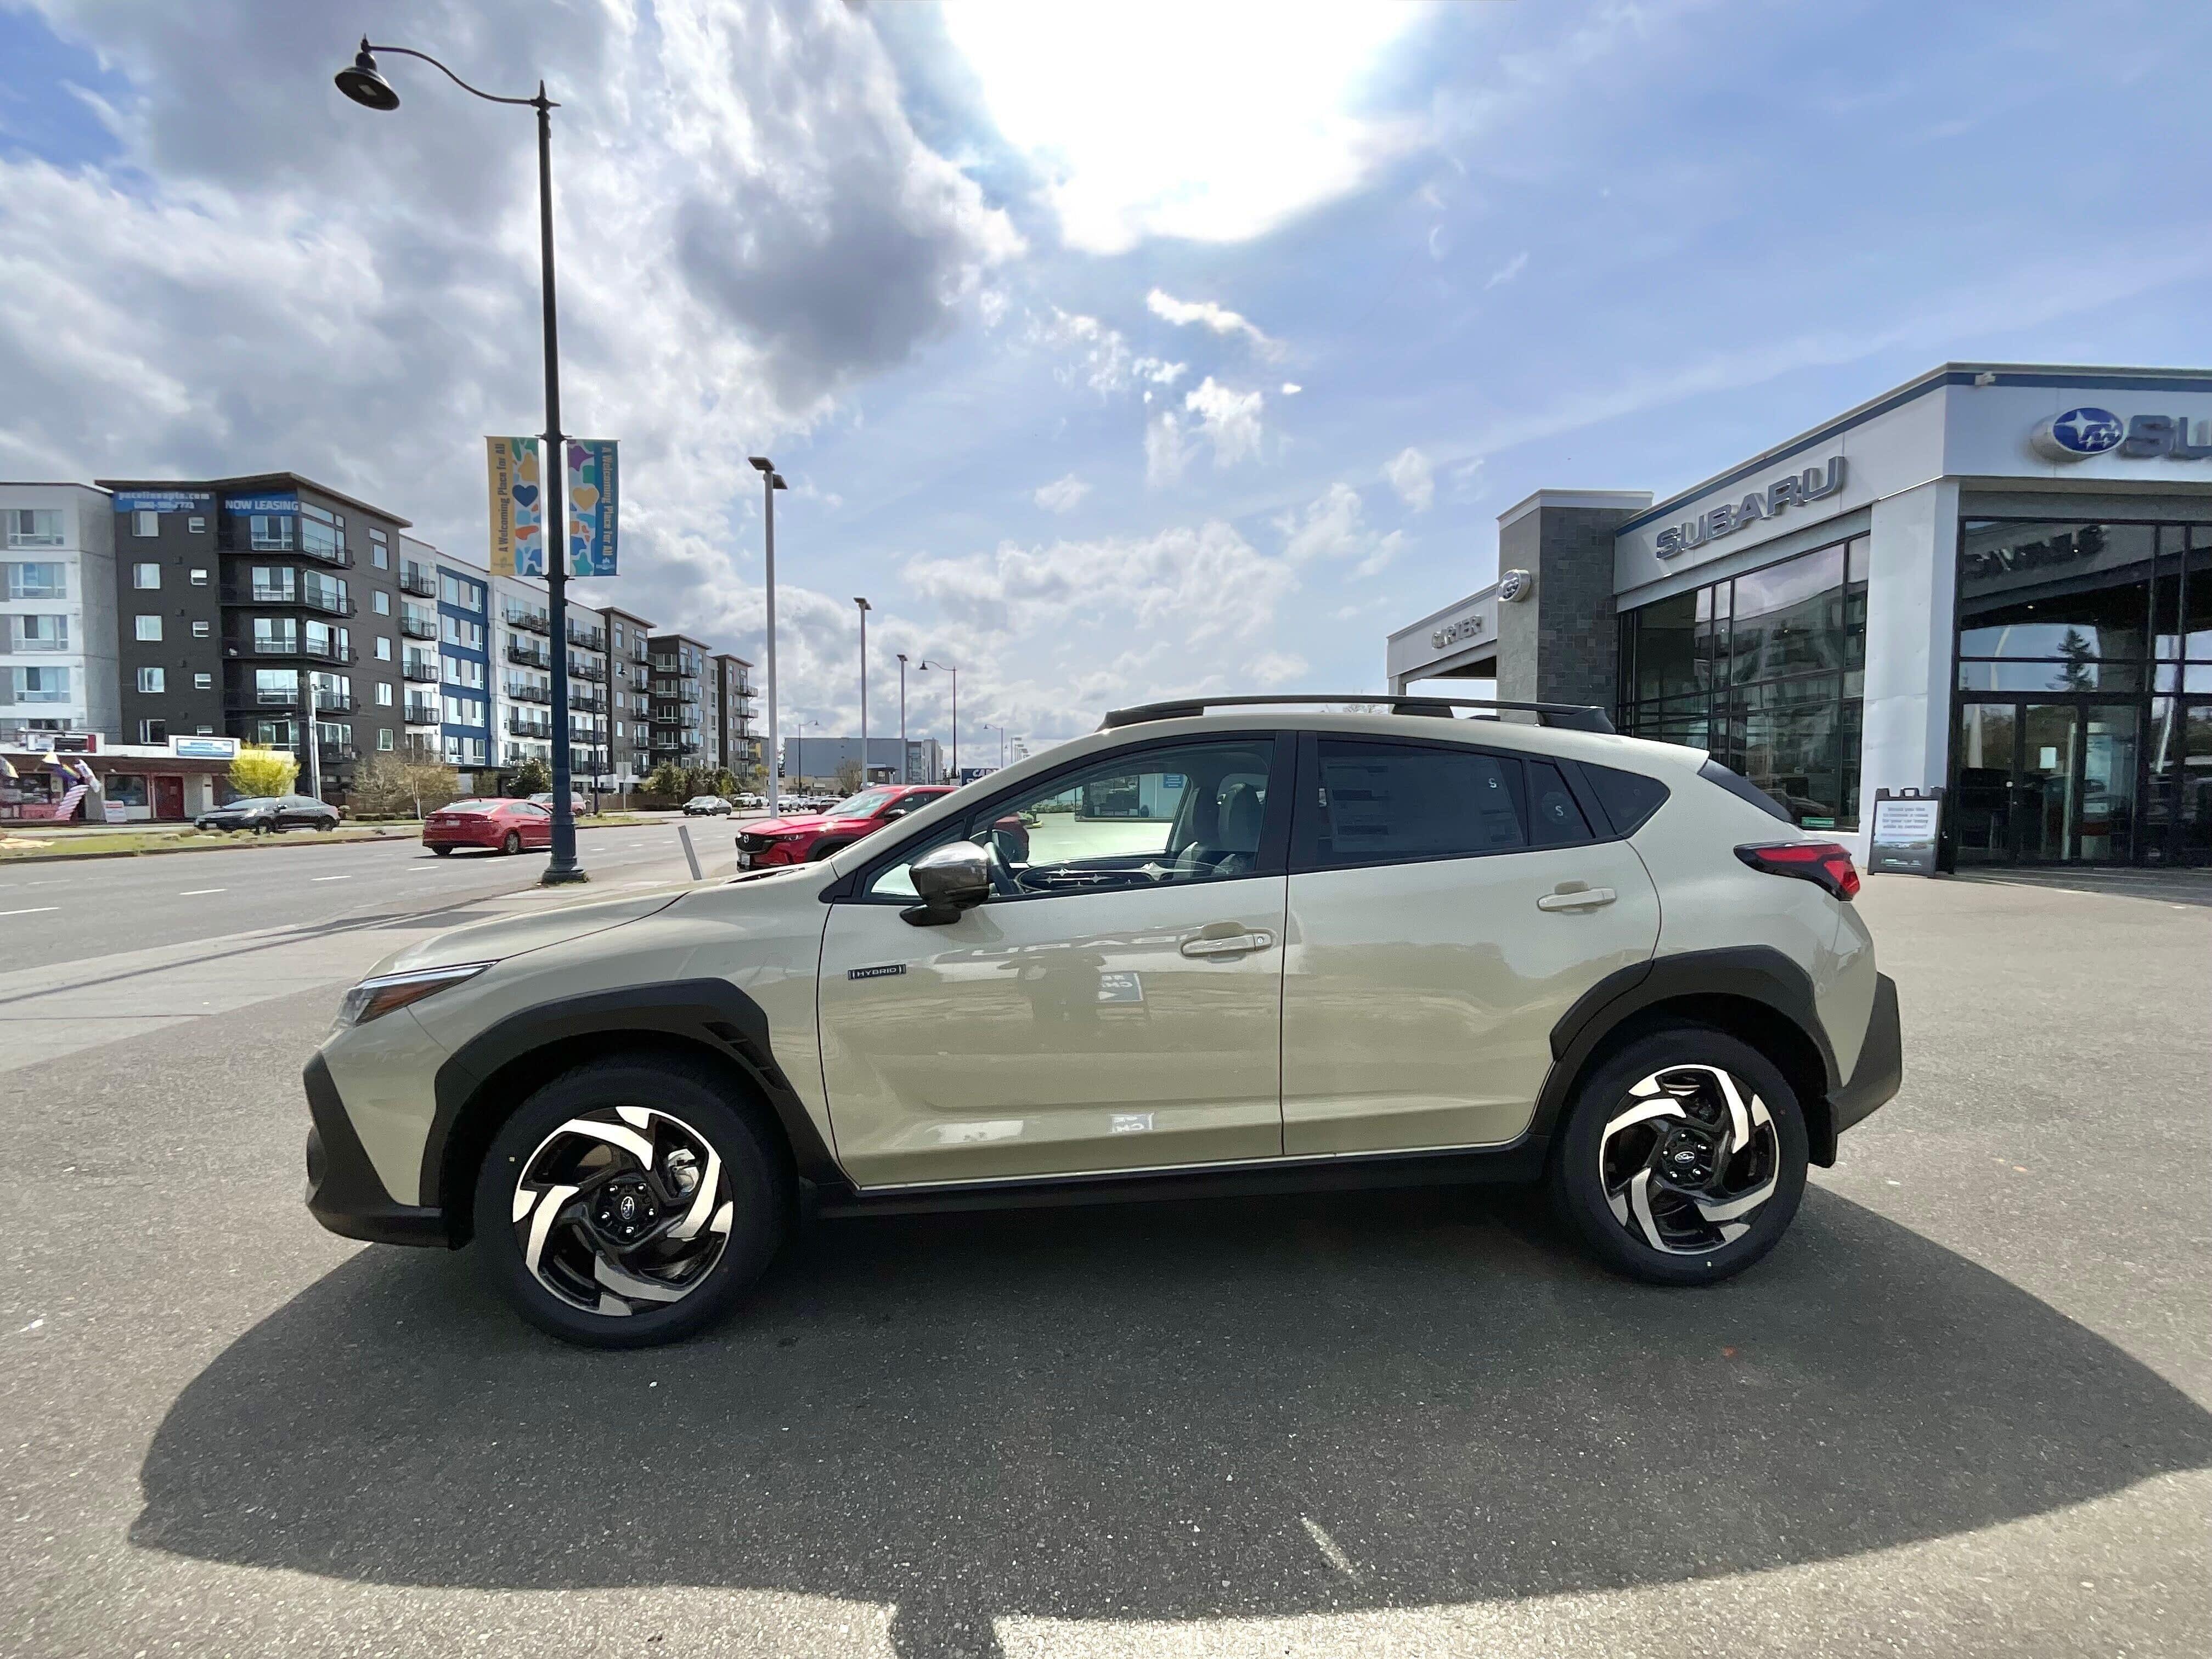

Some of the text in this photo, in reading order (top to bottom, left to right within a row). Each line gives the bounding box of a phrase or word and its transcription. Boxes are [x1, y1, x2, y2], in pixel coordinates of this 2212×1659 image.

[495, 443, 505, 455] All
[496, 458, 506, 469] for
[498, 472, 508, 496] Place
[601, 455, 613, 504] Welcoming
[225, 500, 299, 511] NOW LEASING
[1656, 456, 1845, 560] SUBARU
[498, 498, 510, 545] Welcoming
[603, 505, 614, 529] Place
[602, 531, 613, 544] for
[602, 546, 613, 556] All
[1431, 614, 1482, 649] CARTER
[857, 967, 897, 977] HYBRID
